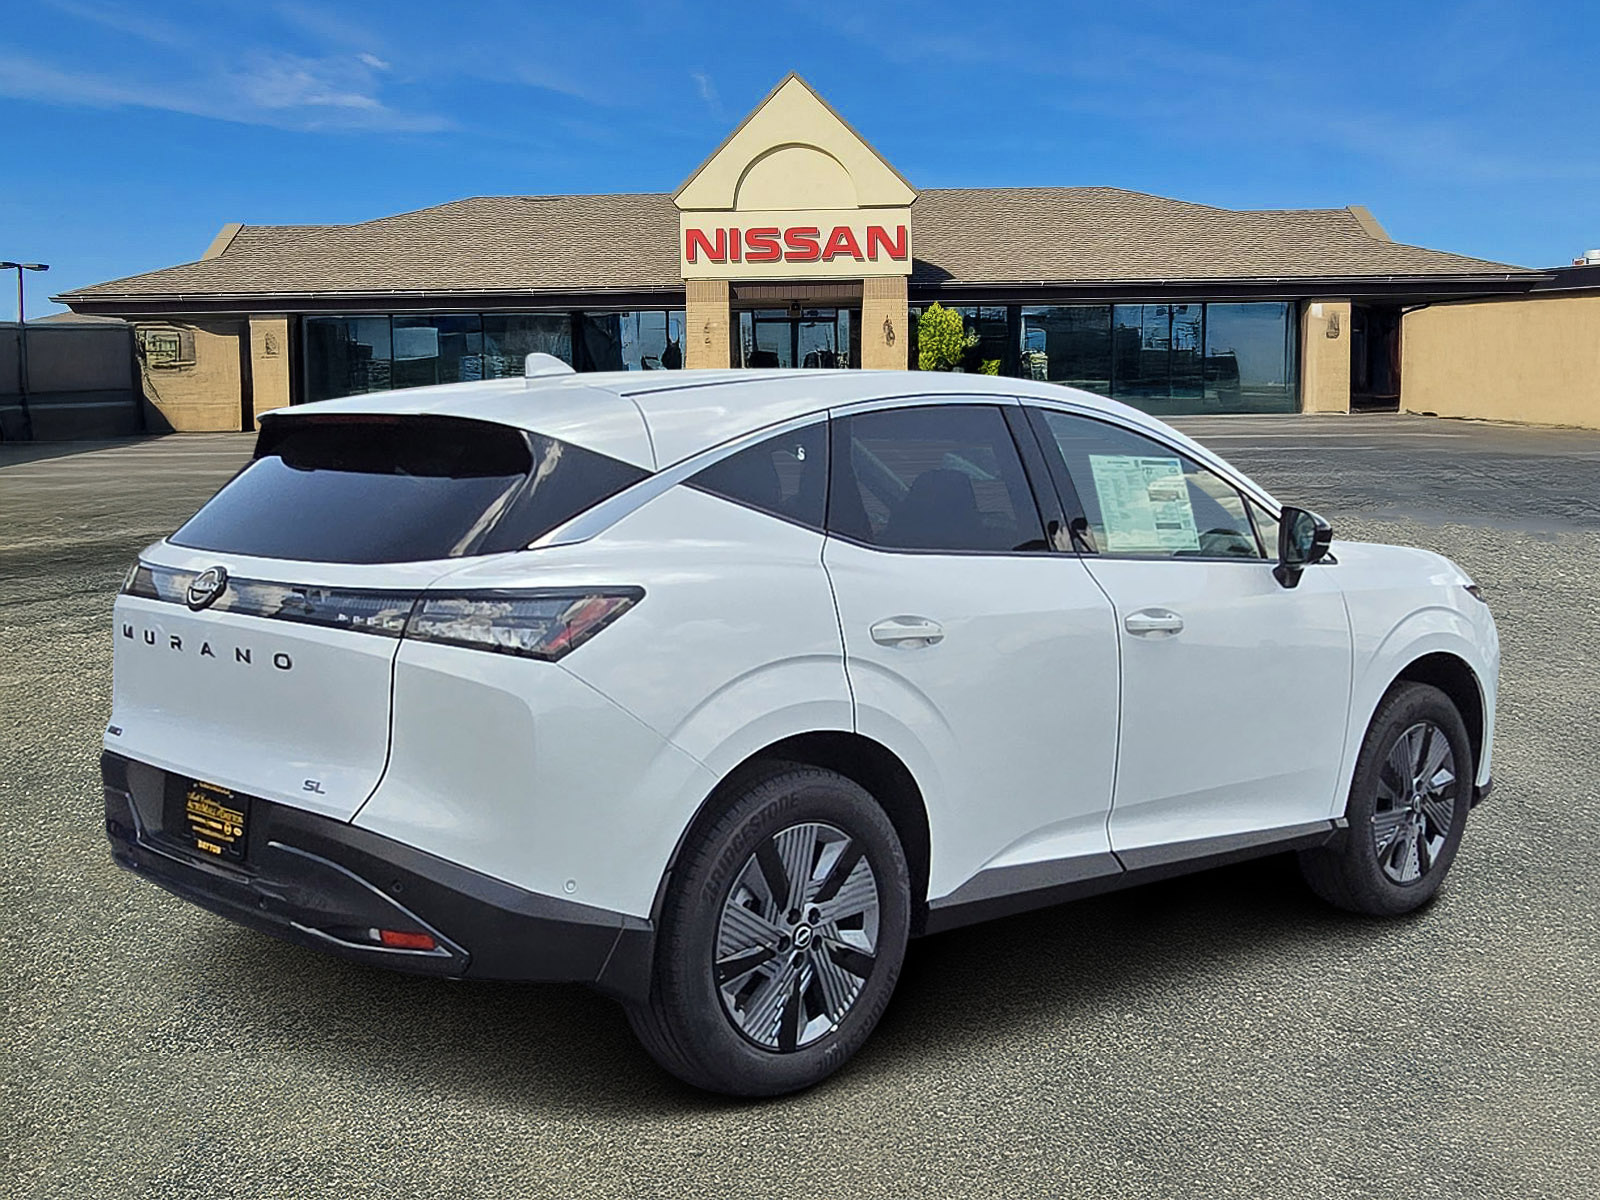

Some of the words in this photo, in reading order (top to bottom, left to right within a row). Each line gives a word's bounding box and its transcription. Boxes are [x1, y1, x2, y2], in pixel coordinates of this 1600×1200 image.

[686, 226, 908, 264] NISSAN
[123, 624, 292, 670] MURANO
[302, 780, 325, 794] SL
[702, 792, 799, 901] BRIDGESTONE
